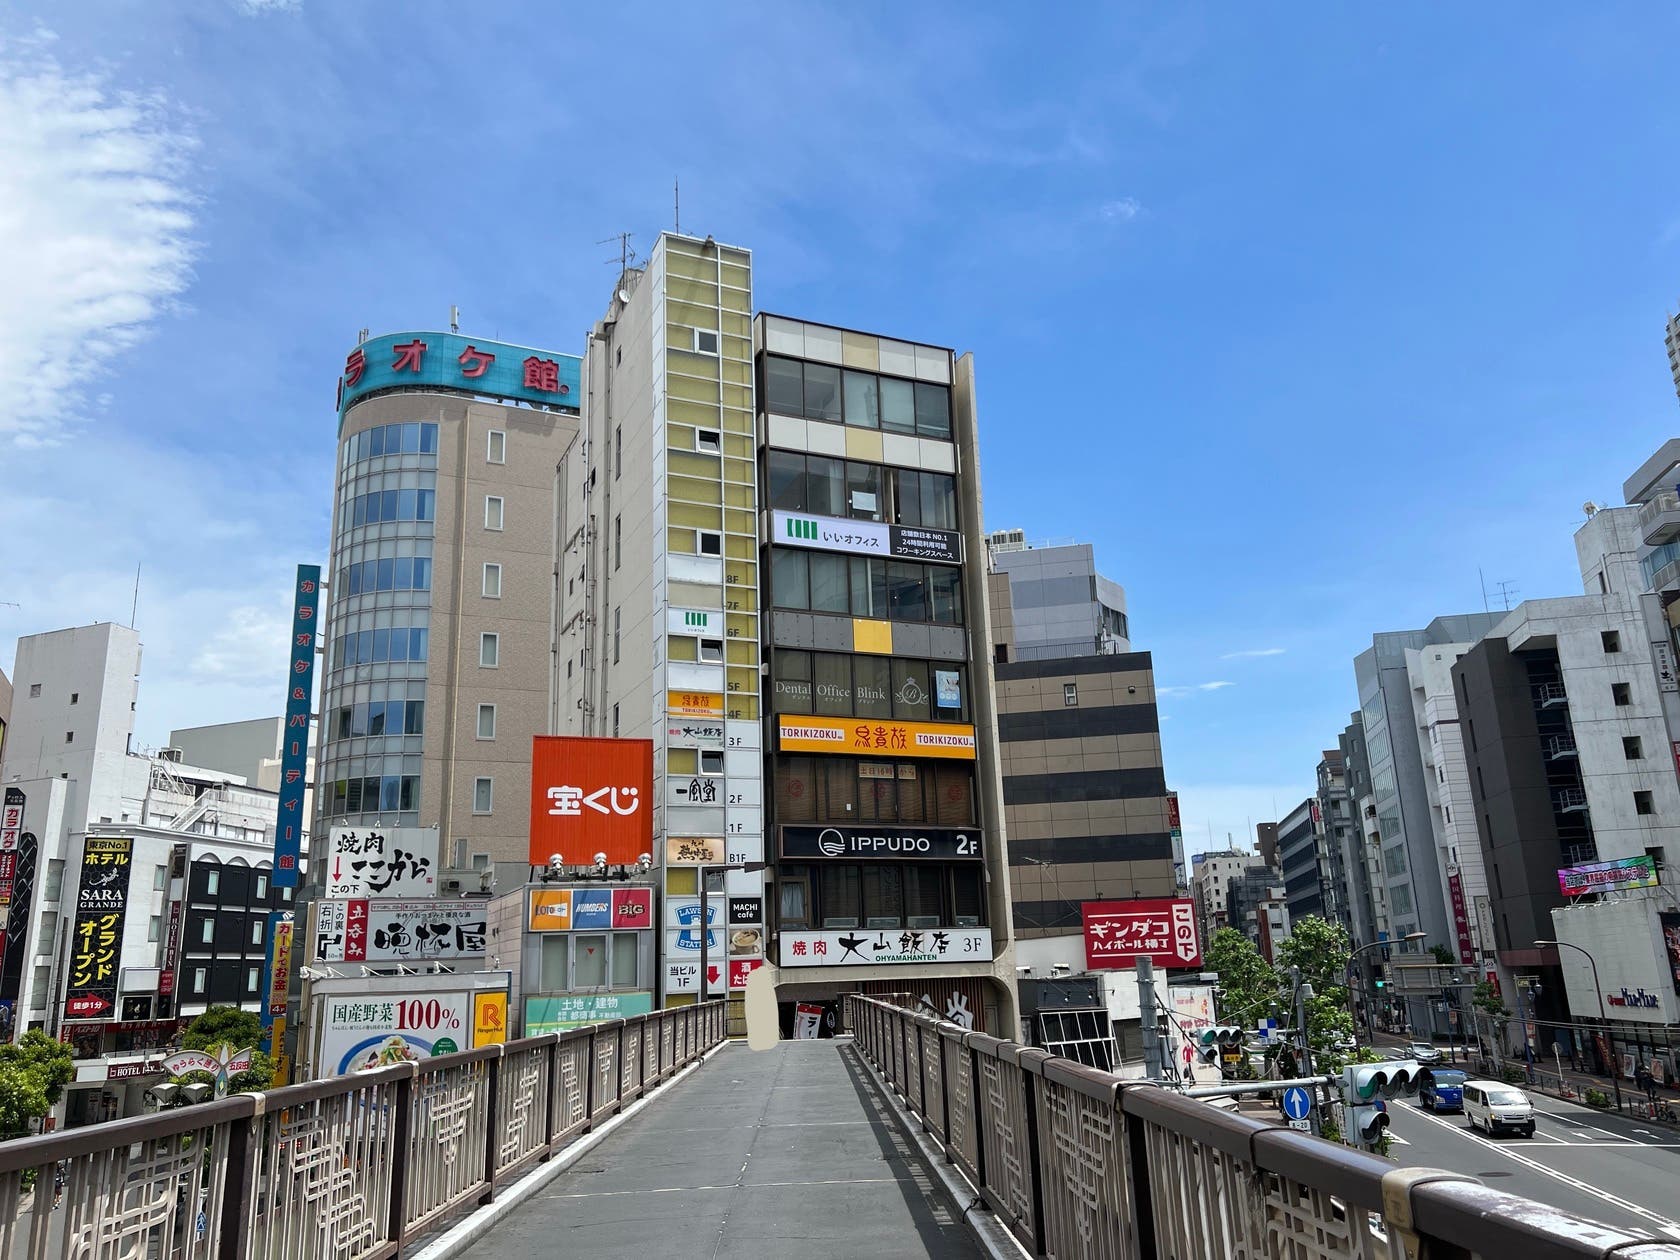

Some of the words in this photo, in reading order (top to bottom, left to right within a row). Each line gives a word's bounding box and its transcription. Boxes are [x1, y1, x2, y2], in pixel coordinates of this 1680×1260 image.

[337, 339, 560, 411] ラオケ館
[823, 531, 879, 547] いいオフィス
[896, 546, 954, 559] コワーキングスペース
[726, 575, 739, 584] 8F
[727, 602, 739, 610] 7F
[727, 628, 740, 637] 6F
[727, 682, 740, 691] 5F
[775, 681, 812, 695] Dental
[816, 684, 850, 697] Office
[857, 687, 886, 700] Blink
[728, 710, 741, 719] 4F
[781, 727, 837, 740] TORIKIZOKU
[854, 725, 907, 749] 鳥貴族
[917, 734, 970, 746] TORIKIZOKU
[728, 737, 742, 746] 3F
[676, 778, 716, 803] 一風堂
[547, 785, 639, 815] 宝くじ
[729, 794, 743, 804] 2F
[729, 823, 743, 833] 1F
[336, 832, 385, 855] 焼肉
[851, 836, 930, 852] IPPUDO
[956, 834, 978, 855] 2F
[85, 853, 129, 866] ホテル
[729, 853, 747, 863] B1F
[80, 889, 124, 900] SARA
[331, 884, 360, 894] この下
[79, 901, 124, 909] GRANDE
[575, 902, 609, 914] NUMBERS
[733, 903, 758, 911] MACHI
[320, 905, 332, 930] 右折
[335, 903, 345, 931] この裏
[679, 907, 713, 917] LAWSN
[347, 905, 366, 957] 立呑み
[1089, 918, 1170, 939] ギンダコ
[1175, 908, 1194, 958] この下
[97, 913, 119, 981] グランド
[680, 939, 713, 948] STATIN
[792, 940, 827, 956] 焼肉
[838, 931, 952, 963] 大山飯店
[963, 937, 982, 953] 3F
[1093, 938, 1169, 951] ハイボール横丁
[73, 920, 98, 987] オープン
[875, 954, 937, 962] OHYAMAHANTEN
[669, 965, 697, 976] 当ビル
[676, 977, 690, 987] 1F
[73, 1000, 103, 1010] 徒歩1分
[561, 996, 618, 1011] 土地・建物
[332, 1002, 393, 1023] 国産野菜
[394, 998, 460, 1031] 100%
[483, 1004, 502, 1026] R
[117, 1066, 141, 1077] HOTEL
